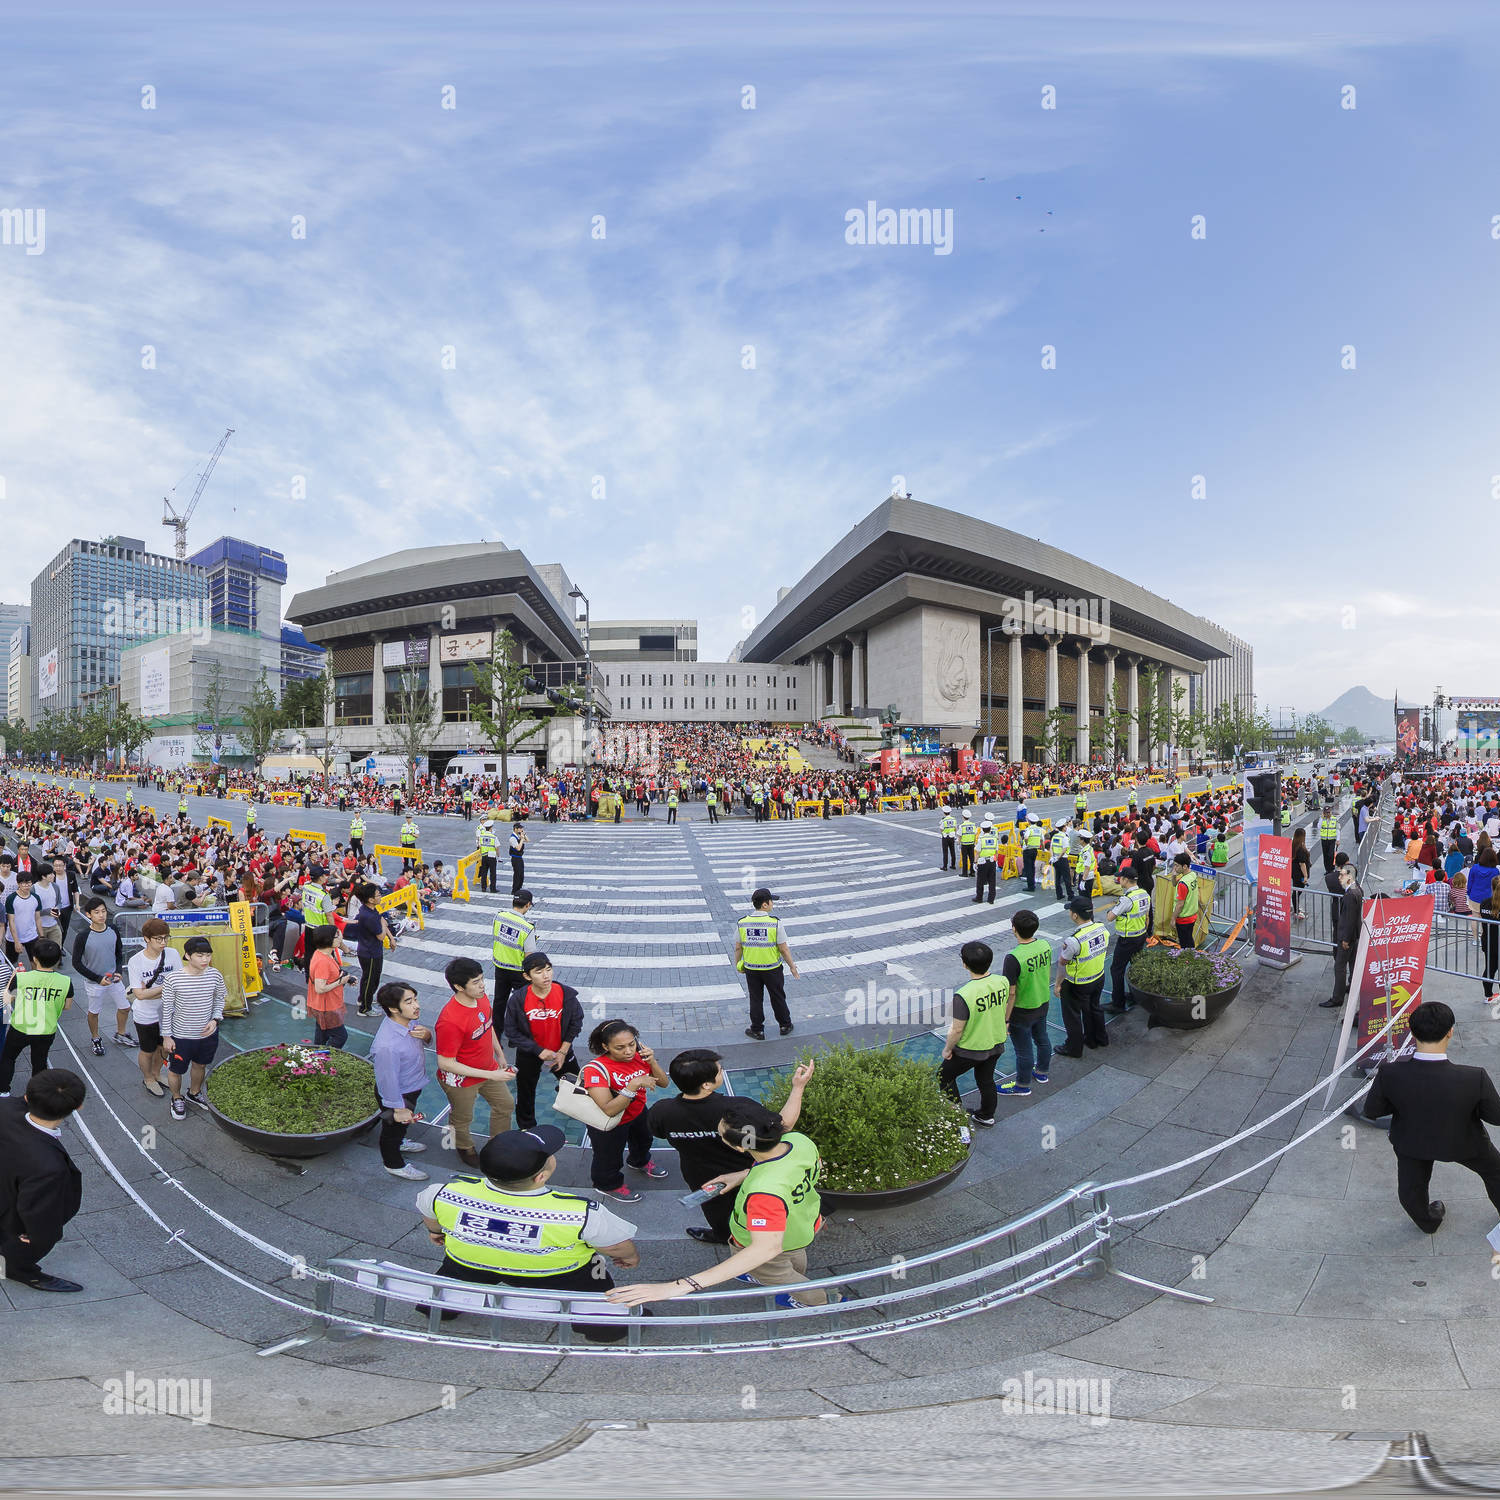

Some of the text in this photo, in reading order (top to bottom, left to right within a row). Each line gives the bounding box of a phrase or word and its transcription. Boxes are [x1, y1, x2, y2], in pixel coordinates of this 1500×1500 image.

[1268, 876, 1281, 886] 안내
[1386, 914, 1411, 925] 2014
[1393, 923, 1428, 935] 거리응원
[1369, 956, 1419, 975] 횡단보도
[1374, 970, 1411, 988] 진입로
[24, 986, 62, 1002] STAFF
[976, 988, 1007, 1012] STAFF
[612, 1069, 646, 1086] Korea
[465, 1213, 531, 1236] 경찰
[462, 1226, 529, 1243] POLICE
